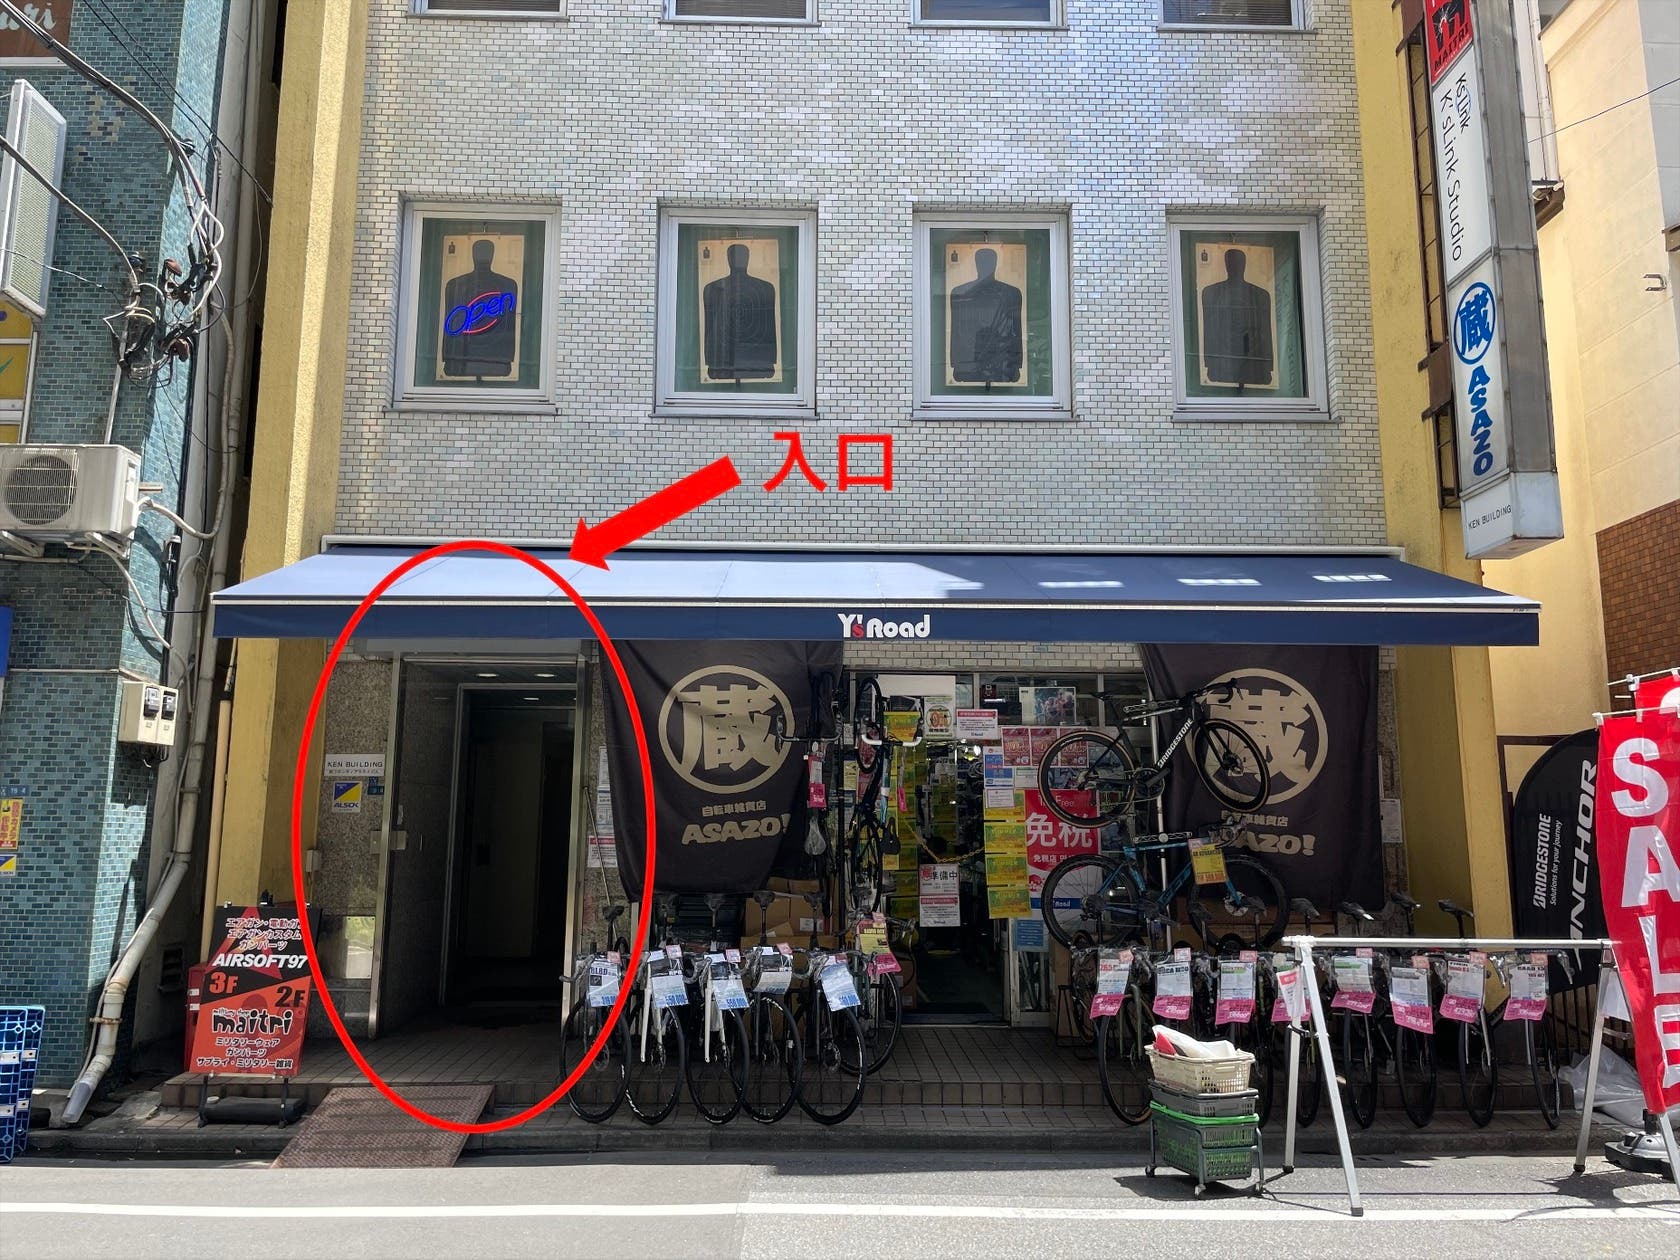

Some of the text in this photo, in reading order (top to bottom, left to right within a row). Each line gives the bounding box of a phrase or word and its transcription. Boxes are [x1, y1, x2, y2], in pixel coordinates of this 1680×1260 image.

[1447, 180, 1465, 261] Studio
[444, 292, 515, 336] Open
[1467, 365, 1494, 476] ASAZO
[1468, 504, 1512, 530] KEN BUILDING
[1157, 717, 1193, 769] BRIDGESTONE
[682, 813, 791, 845] ASAZO!
[1553, 820, 1562, 847] journey
[1532, 812, 1552, 909] BRIDGESTONE
[1552, 848, 1561, 863] your
[1549, 875, 1559, 906] Solutions
[212, 953, 309, 969] AIRSOFT97
[209, 971, 239, 994] 3F
[274, 986, 306, 1008] 2F
[212, 1009, 293, 1035] maitri
